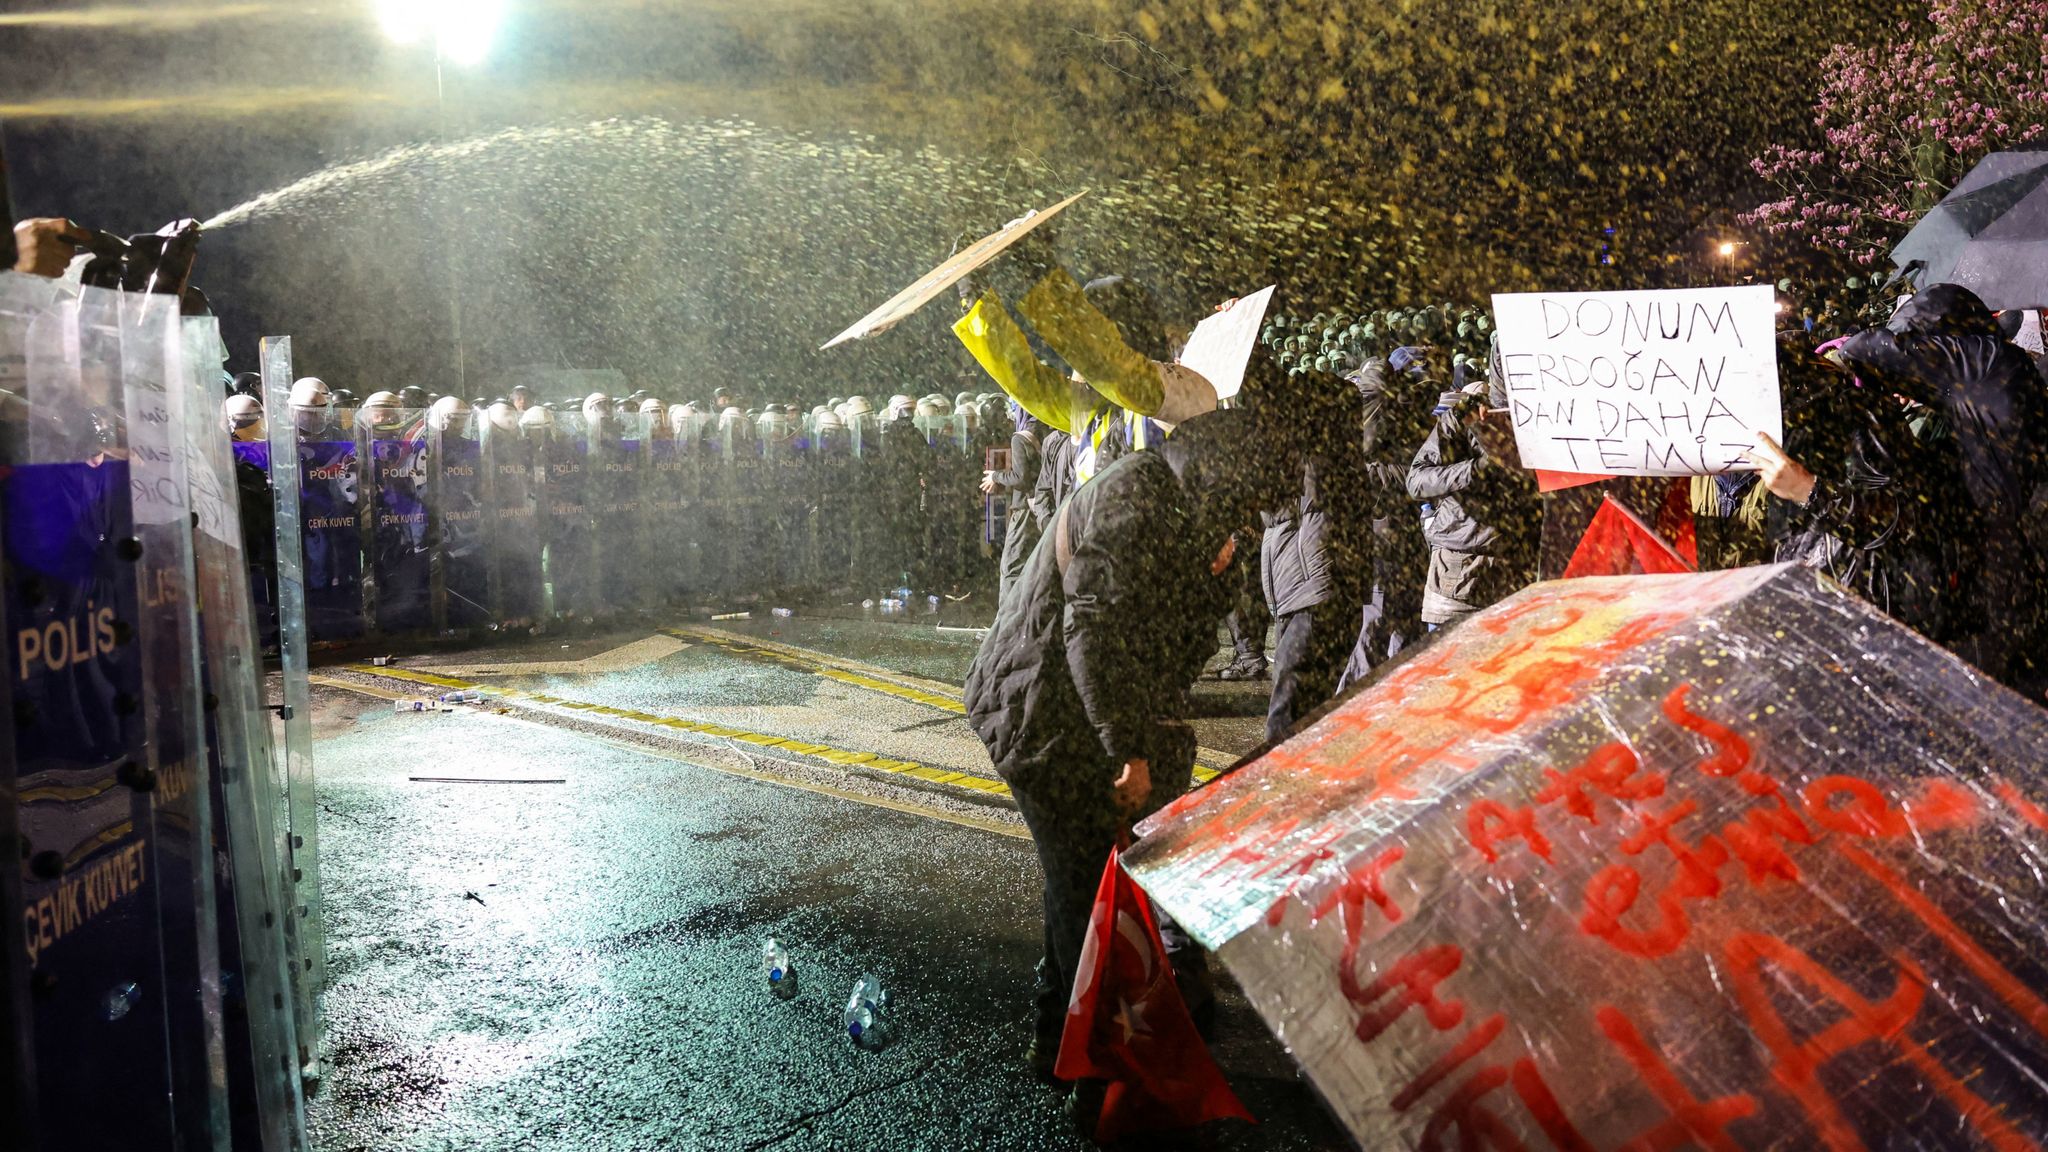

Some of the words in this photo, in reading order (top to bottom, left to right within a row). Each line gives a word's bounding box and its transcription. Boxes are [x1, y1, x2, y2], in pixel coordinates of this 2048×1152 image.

[1541, 298, 1743, 348] DONUM
[1513, 398, 1575, 427] DAN
[1596, 397, 1749, 437] DAHA
[309, 469, 346, 480] POLİS
[382, 468, 417, 478] POLİS
[308, 518, 328, 530] ÇEVİK
[329, 517, 355, 528] KUVVET
[380, 514, 399, 526] ÇEVİK
[400, 513, 425, 524] KUVVET
[18, 600, 116, 680] POLİS
[24, 873, 83, 968] ÇEVİK
[85, 839, 146, 917] KUVVET
